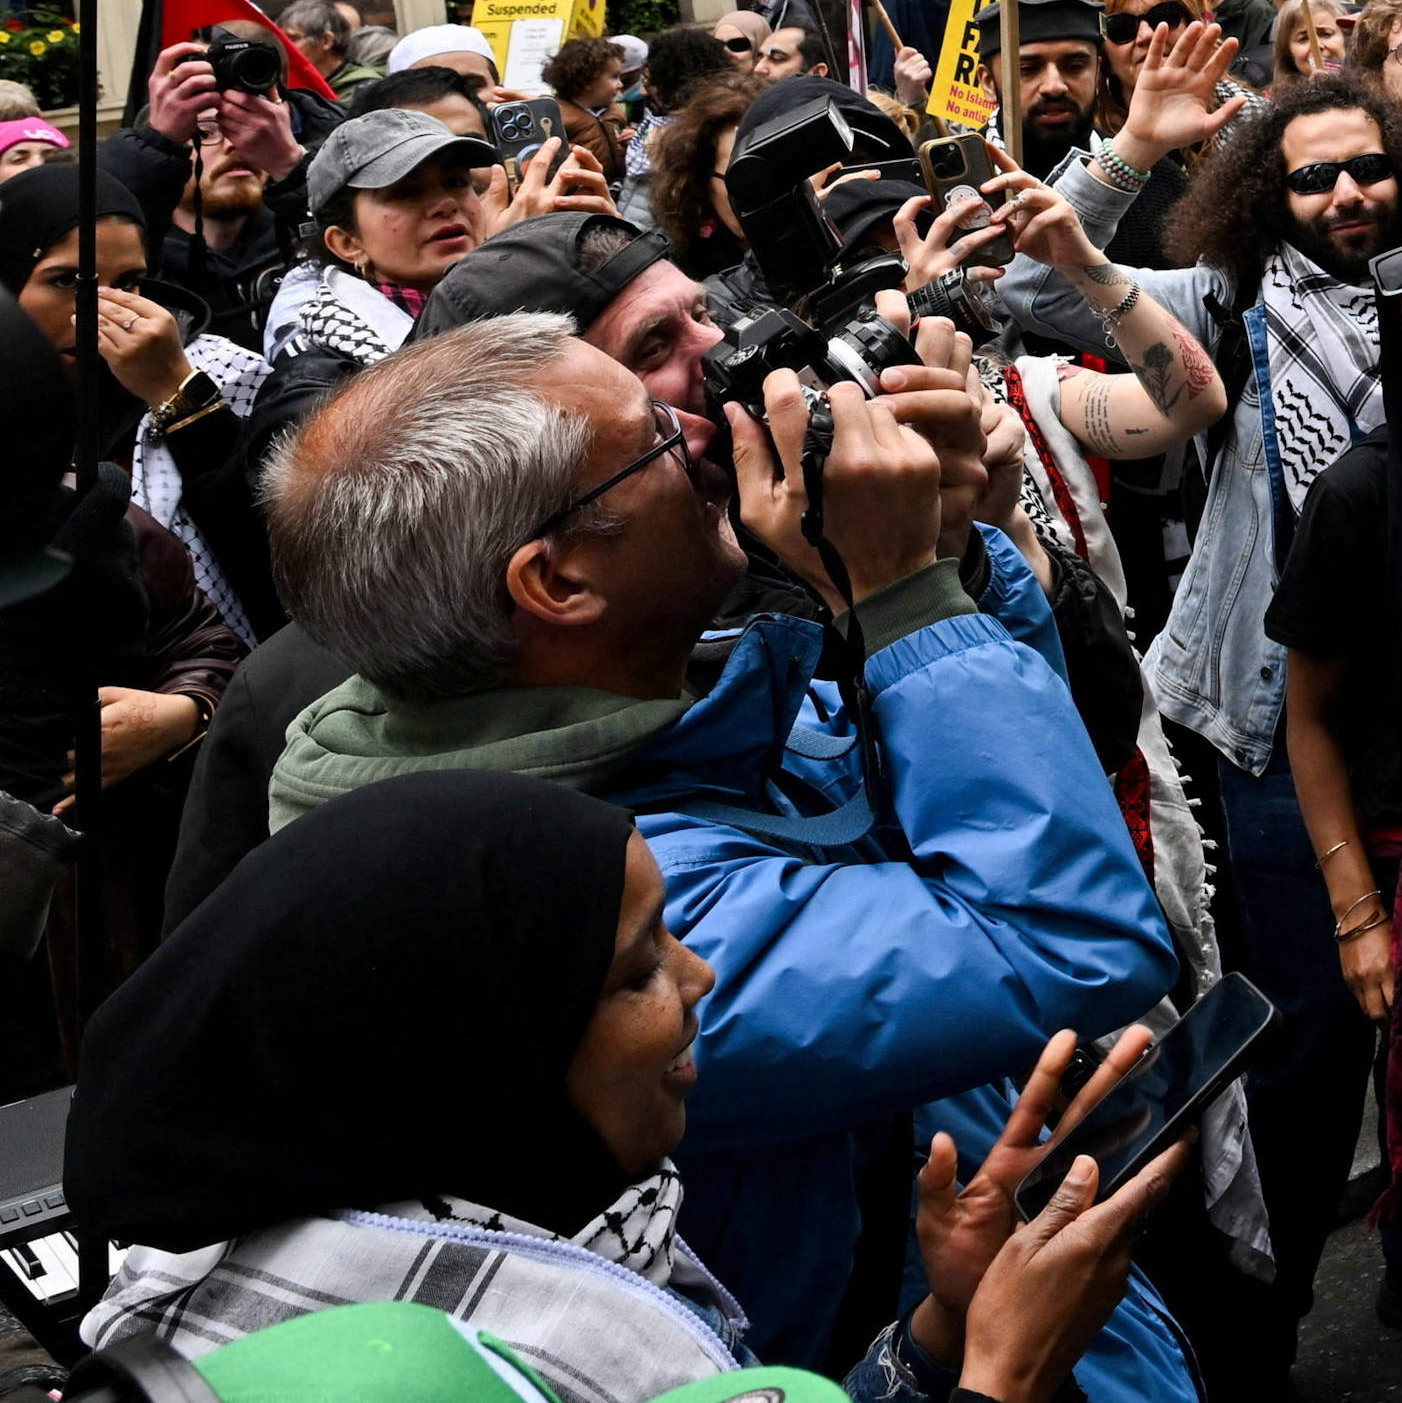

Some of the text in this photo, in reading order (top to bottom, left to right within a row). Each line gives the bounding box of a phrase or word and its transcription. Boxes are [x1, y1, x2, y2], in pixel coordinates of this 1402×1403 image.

[487, 2, 557, 18] Suspended
[949, 84, 964, 100] No
[945, 100, 960, 114] No
